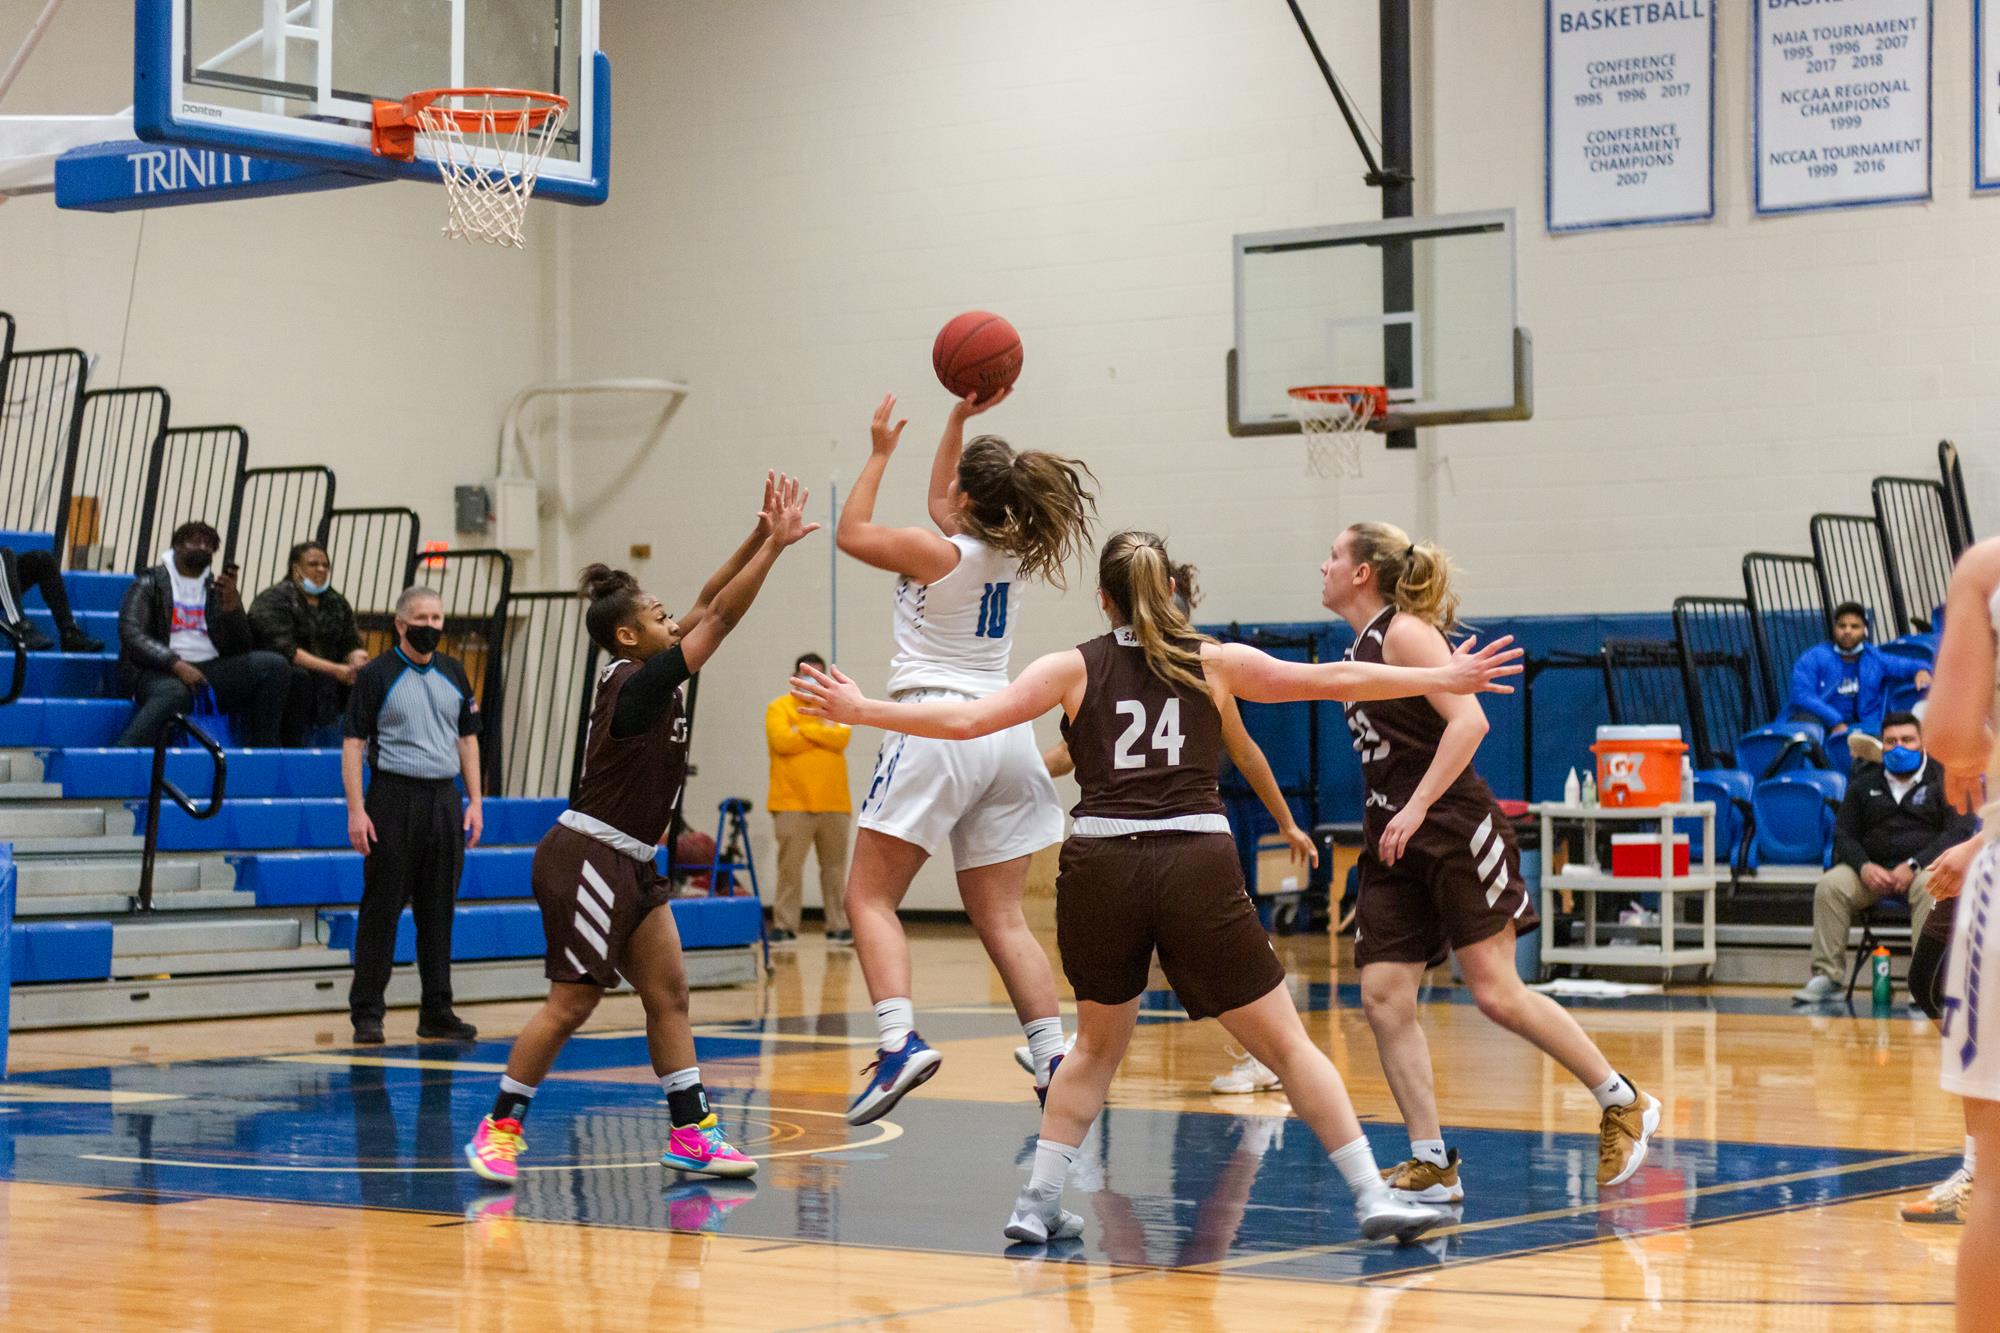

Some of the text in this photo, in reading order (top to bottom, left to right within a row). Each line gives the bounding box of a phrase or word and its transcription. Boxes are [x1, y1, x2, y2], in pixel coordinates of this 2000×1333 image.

[1560, 0, 1704, 33] BASKETBALL
[1773, 17, 1918, 46] NAIA TOURNAMENT
[1783, 35, 1908, 61] 1995 1996 2007
[1586, 53, 1677, 75] CONFERENCE
[1806, 54, 1883, 74] 2017 2018
[1590, 69, 1674, 90] CHAMPIONS
[1574, 83, 1691, 107] 1995 1996 2017
[1781, 80, 1911, 104] NCCAA REGIONAL
[1800, 96, 1891, 117] CHAMPIONS
[1830, 115, 1862, 130] 1999
[1586, 123, 1677, 144] CONFERENCE
[1583, 138, 1681, 159] TOURNAMENT
[1770, 138, 1922, 165] NCCAA TOURNAMENT
[1590, 153, 1674, 172] CHAMPIONS
[1808, 159, 1886, 178] 1999 2016
[1616, 172, 1648, 187] 2007
[975, 582, 1011, 638] 10
[1114, 697, 1187, 770] 24
